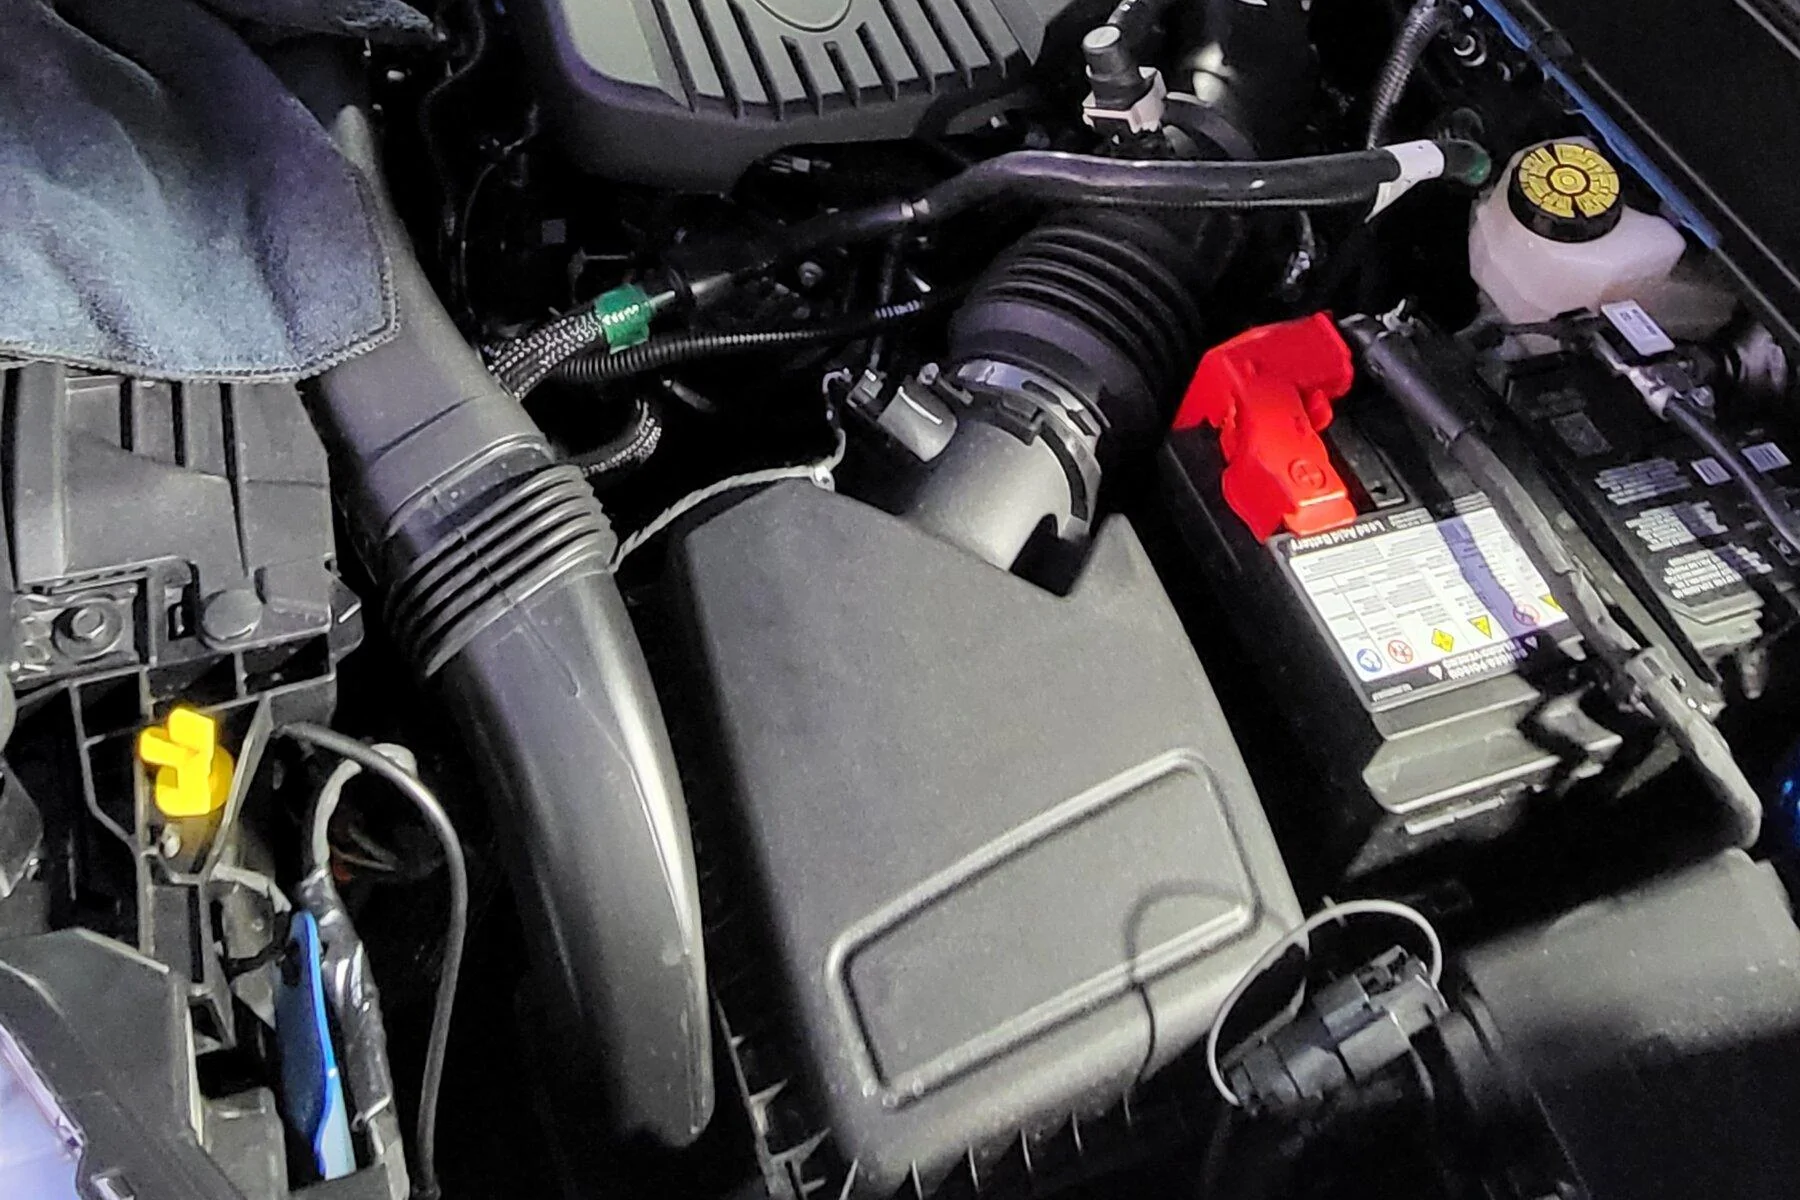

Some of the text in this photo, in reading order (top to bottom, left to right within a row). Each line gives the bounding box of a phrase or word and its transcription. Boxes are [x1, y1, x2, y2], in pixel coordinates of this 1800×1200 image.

[1290, 519, 1386, 551] Lead Acid Battery
